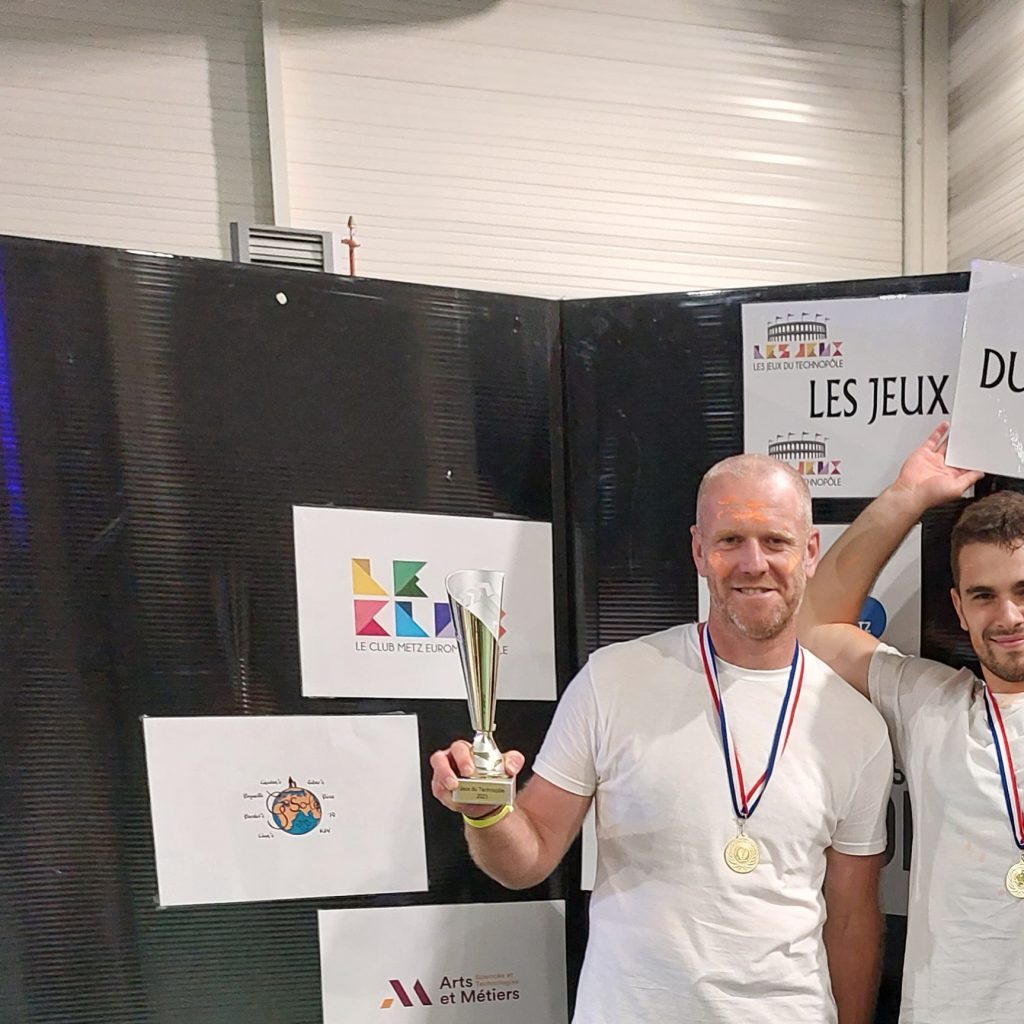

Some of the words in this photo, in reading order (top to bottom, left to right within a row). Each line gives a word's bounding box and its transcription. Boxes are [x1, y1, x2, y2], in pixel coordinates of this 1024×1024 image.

[753, 362, 766, 371] LES
[766, 362, 782, 371] JEUX
[783, 361, 795, 370] DU
[796, 358, 844, 370] TECHNOPÔLE
[809, 378, 858, 418] LES
[867, 375, 950, 425] JEUX
[355, 641, 366, 651] LE
[368, 641, 395, 652] CLUB
[397, 643, 423, 653] METZ
[440, 976, 473, 989] Arts
[440, 992, 456, 1005] et
[461, 988, 520, 1003] Métiers
